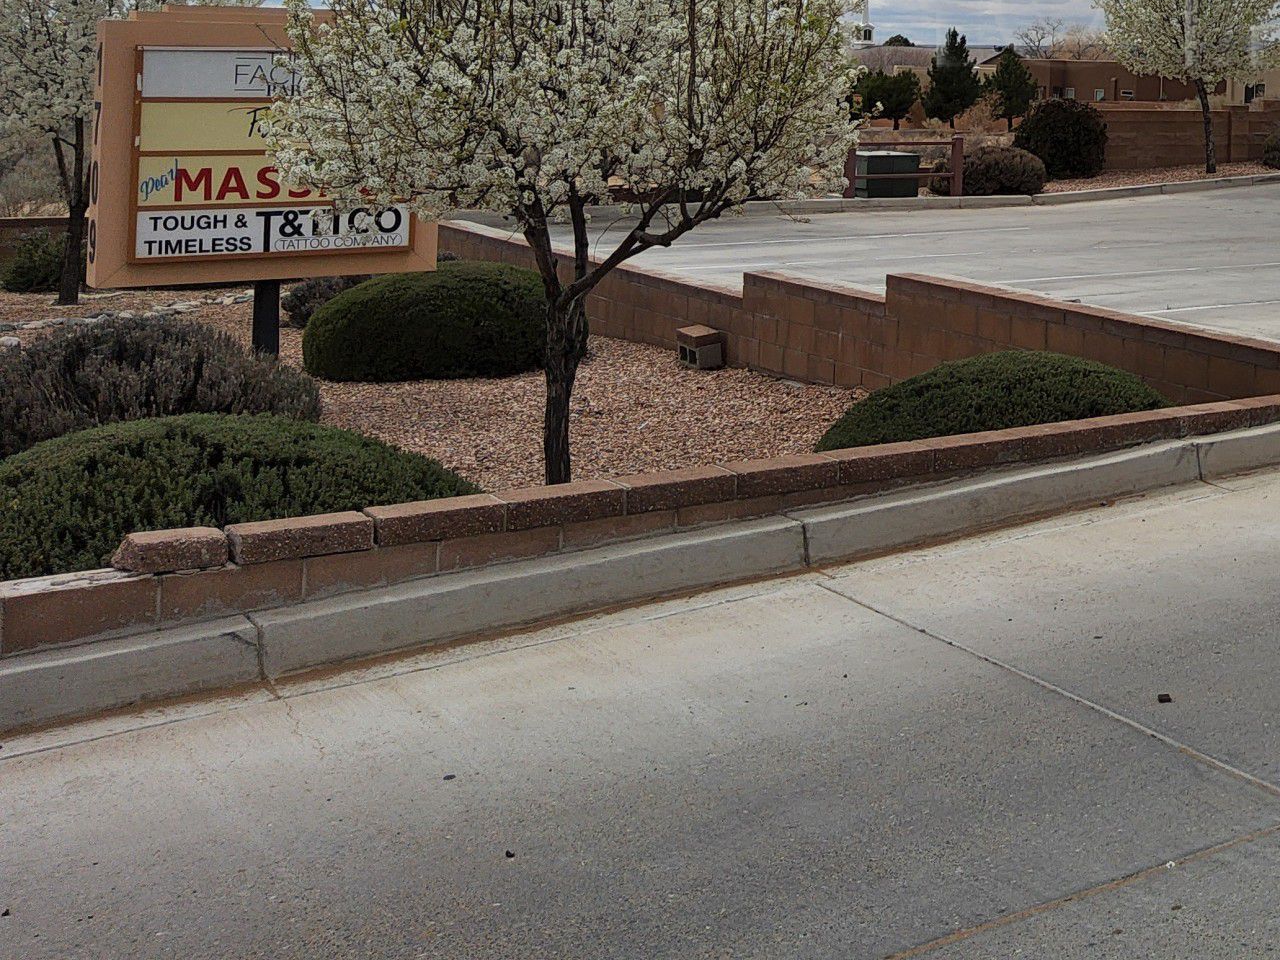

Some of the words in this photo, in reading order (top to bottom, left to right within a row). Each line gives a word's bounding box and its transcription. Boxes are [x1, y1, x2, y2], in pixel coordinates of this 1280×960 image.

[149, 214, 228, 231] TOUGH
[234, 213, 248, 228] &
[143, 236, 252, 255] TIMELESS
[279, 238, 330, 249] TATTOO
